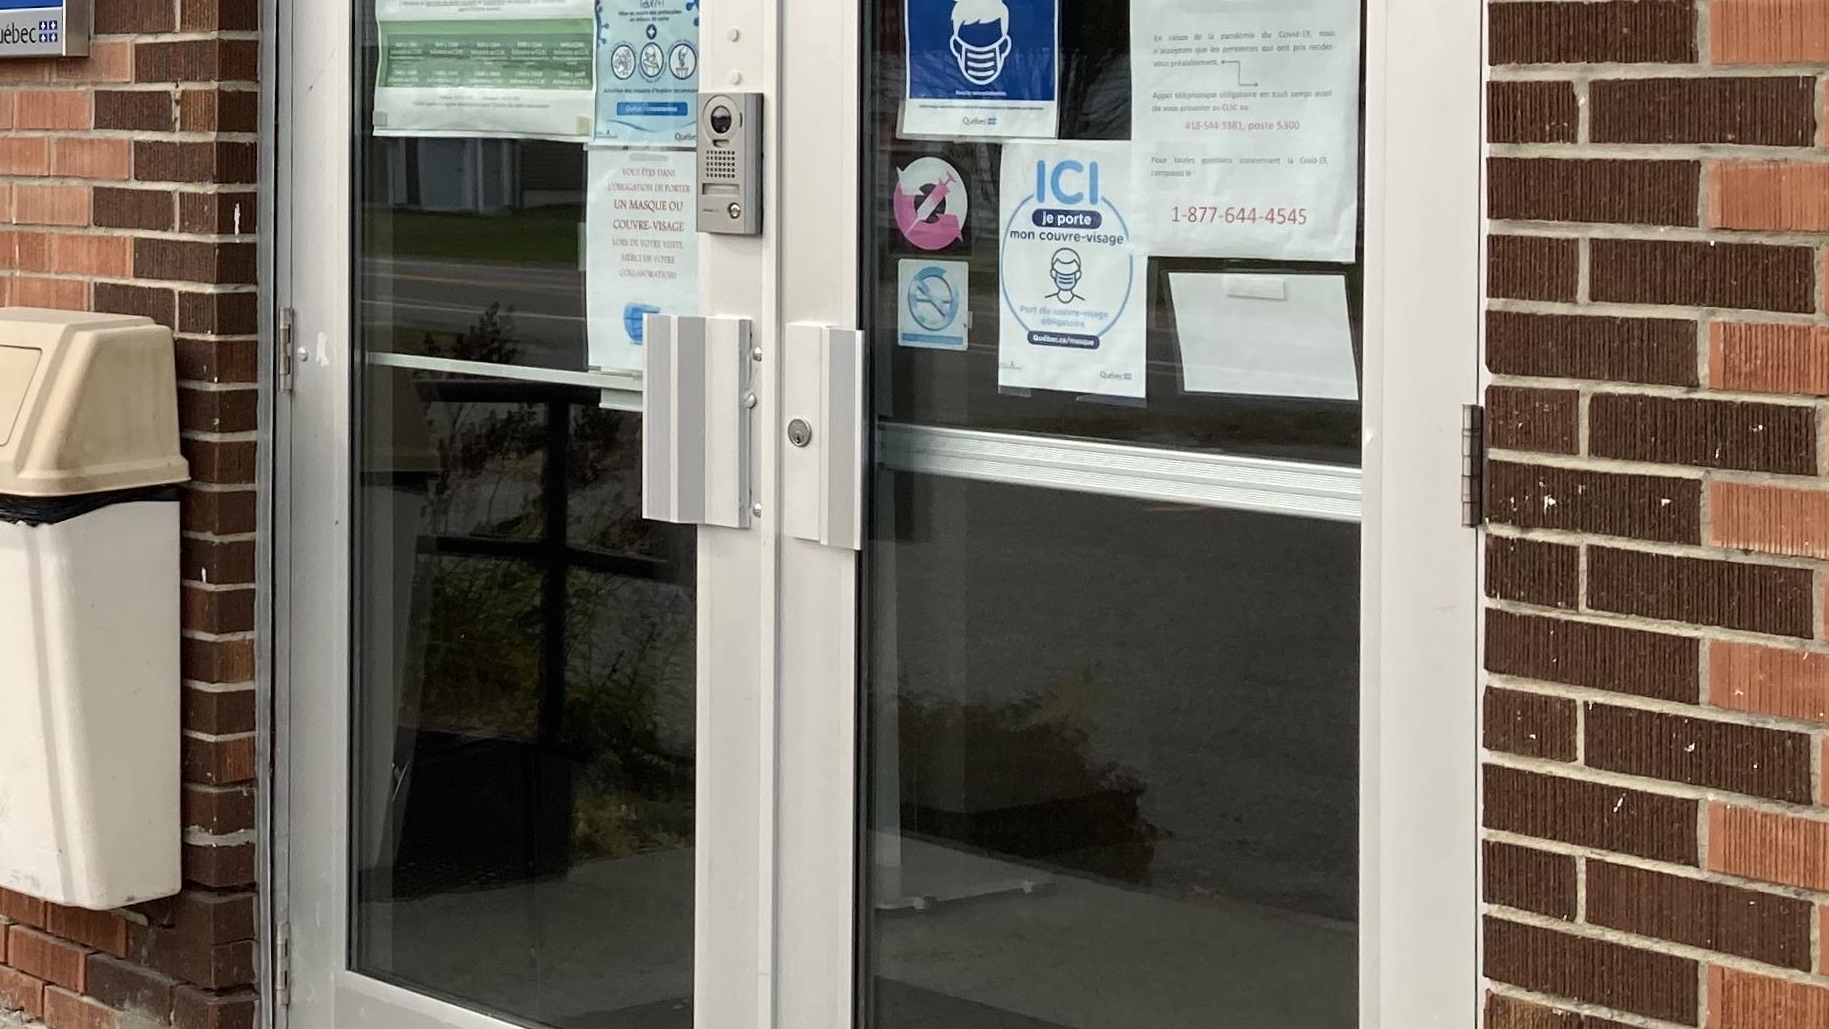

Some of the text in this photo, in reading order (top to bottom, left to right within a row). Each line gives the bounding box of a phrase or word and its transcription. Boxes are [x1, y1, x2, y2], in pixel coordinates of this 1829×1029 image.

[1036, 159, 1099, 205] ICI
[614, 199, 683, 212] UN MASQUE OU
[1042, 211, 1092, 226] je porte
[1171, 206, 1307, 226] 1-877-644-4545
[1010, 230, 1124, 246] mon couvre-visage
